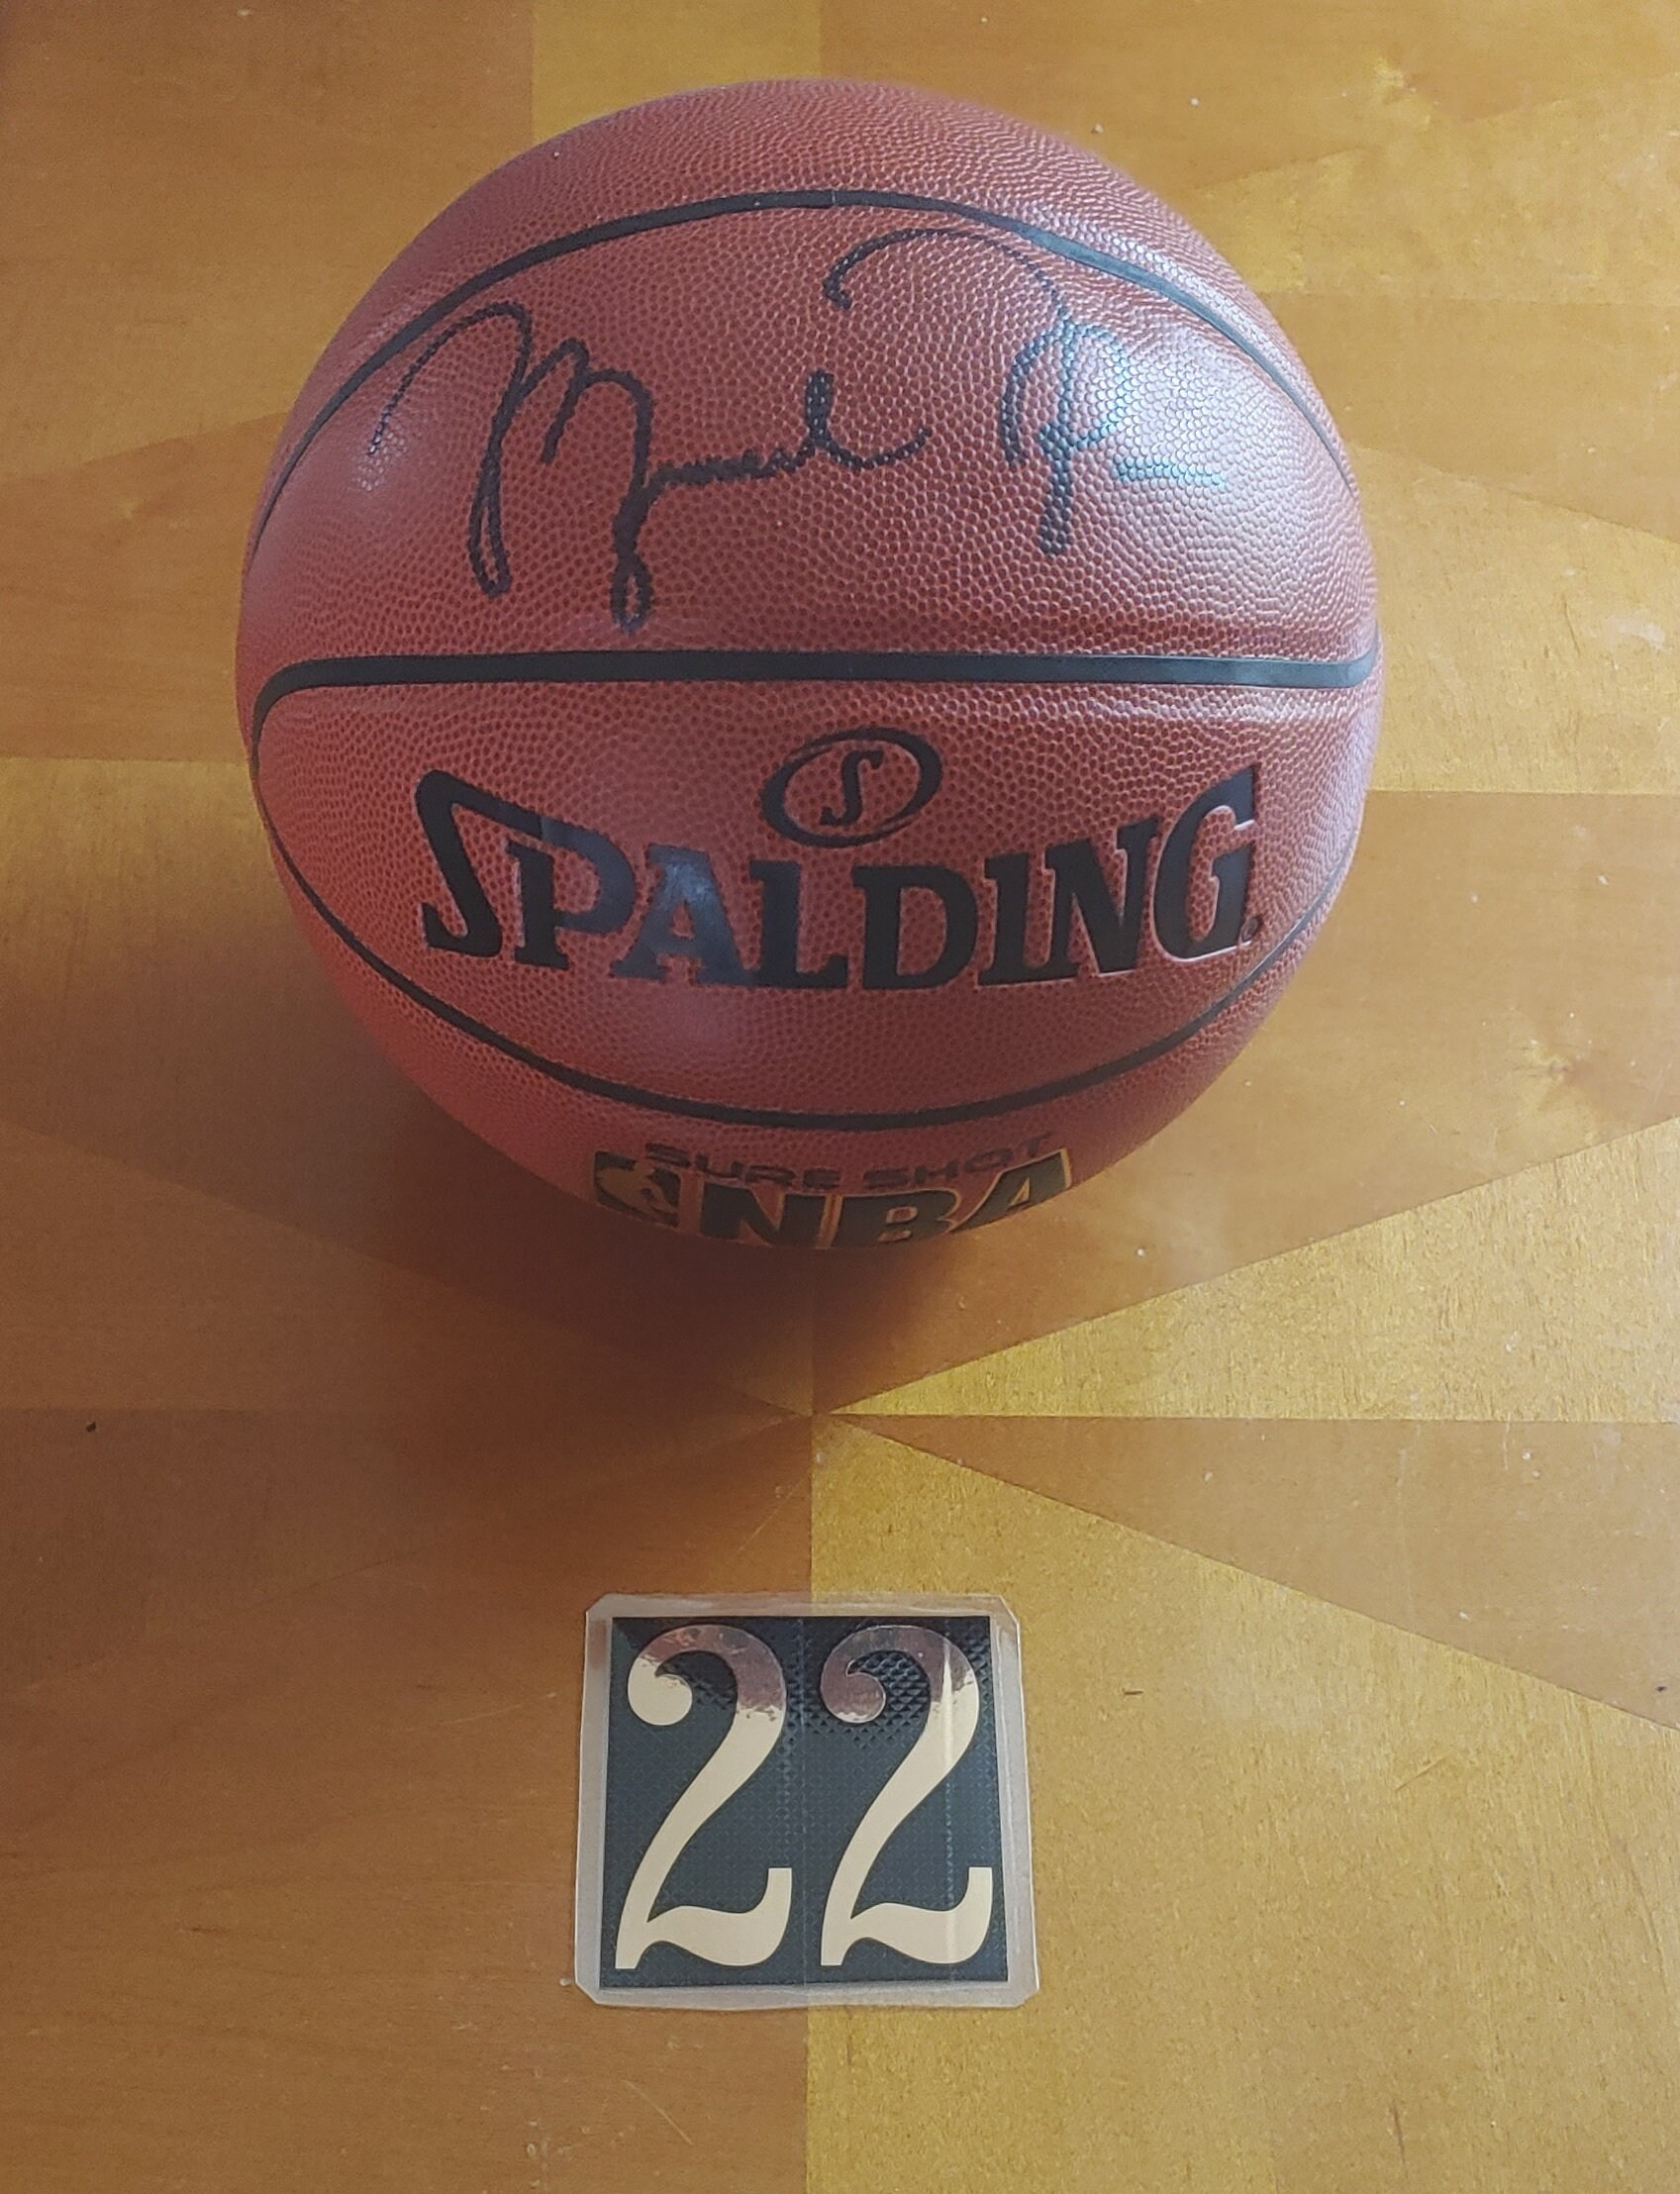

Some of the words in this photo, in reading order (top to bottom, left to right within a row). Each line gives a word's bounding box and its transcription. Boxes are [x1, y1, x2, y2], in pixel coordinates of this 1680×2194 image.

[415, 764, 1261, 993] SPALDING
[644, 1142, 841, 1190] SURE
[862, 1132, 1051, 1188] SHOT
[699, 1147, 1073, 1250] NBA
[614, 1624, 994, 1970] 22
